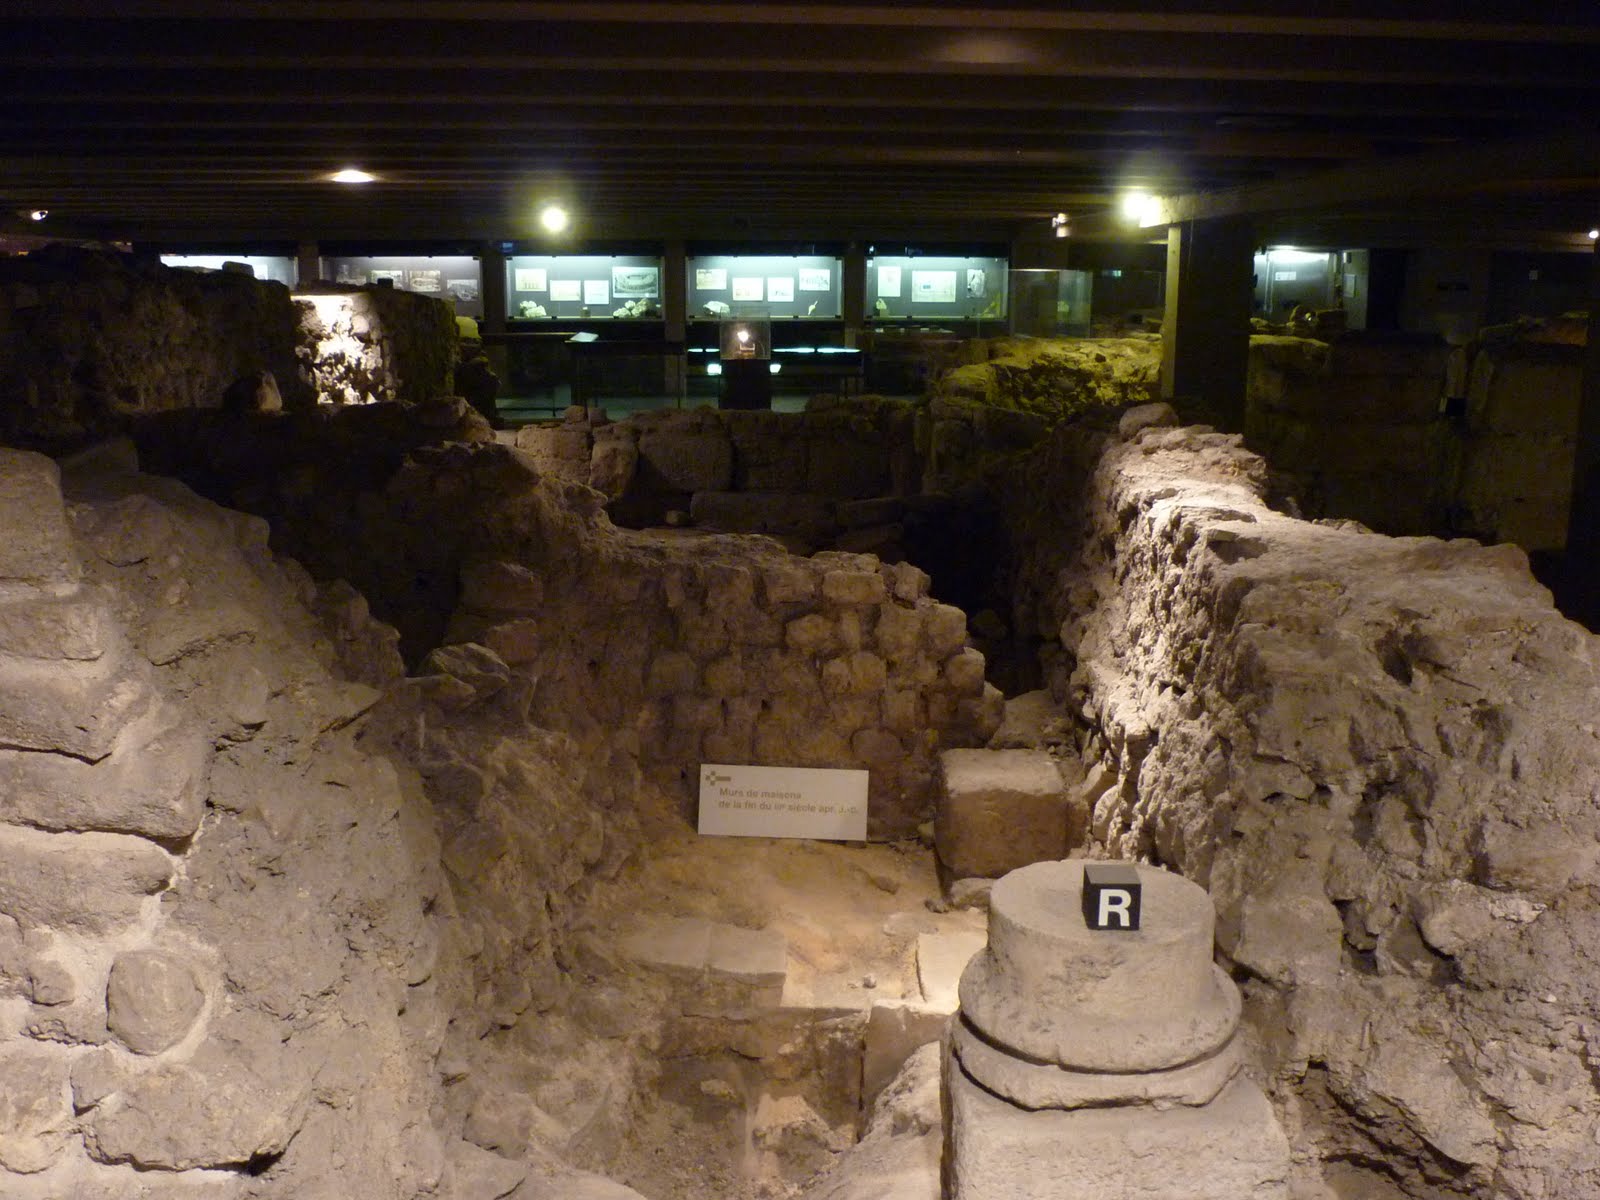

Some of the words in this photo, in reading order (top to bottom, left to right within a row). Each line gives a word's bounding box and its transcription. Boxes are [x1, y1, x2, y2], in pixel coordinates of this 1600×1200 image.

[719, 787, 743, 797] Murs
[746, 788, 758, 797] de
[761, 789, 802, 799] maisons
[718, 800, 730, 809] de
[744, 800, 757, 809] fin
[760, 801, 771, 810] du
[1098, 888, 1131, 927] R
